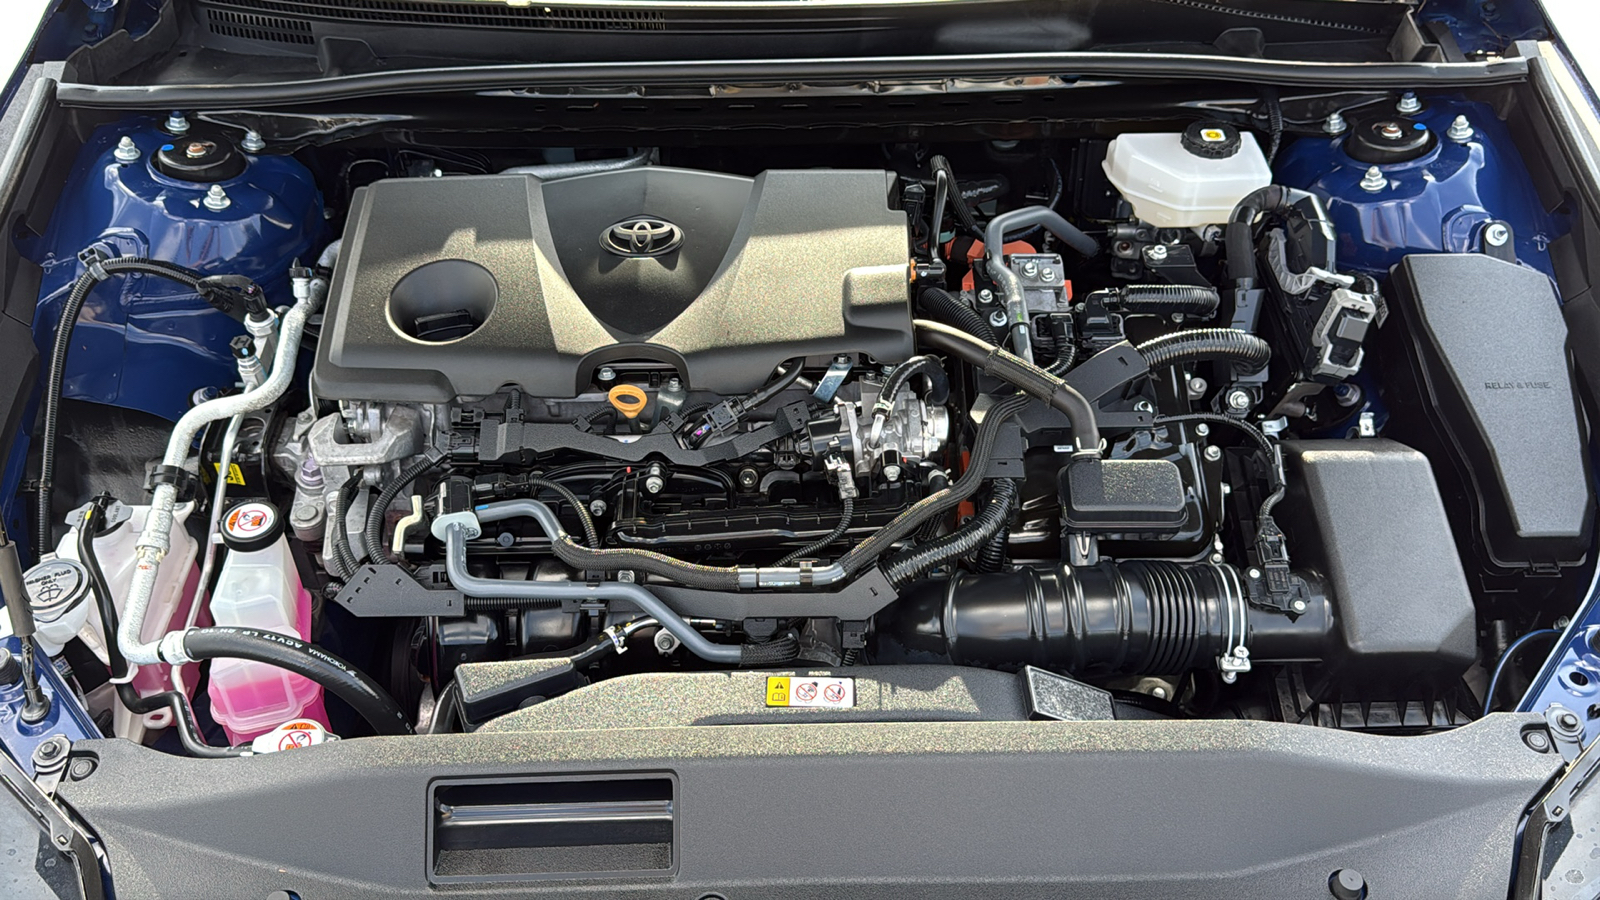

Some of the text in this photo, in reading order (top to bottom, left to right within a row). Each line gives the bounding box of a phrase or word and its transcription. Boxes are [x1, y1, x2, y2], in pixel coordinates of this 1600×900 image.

[1484, 382, 1515, 390] RELAY
[1525, 381, 1552, 389] FUSE
[54, 569, 72, 578] FLUID
[41, 578, 57, 586] ONLY
[308, 647, 347, 671] YOKOHAMA
